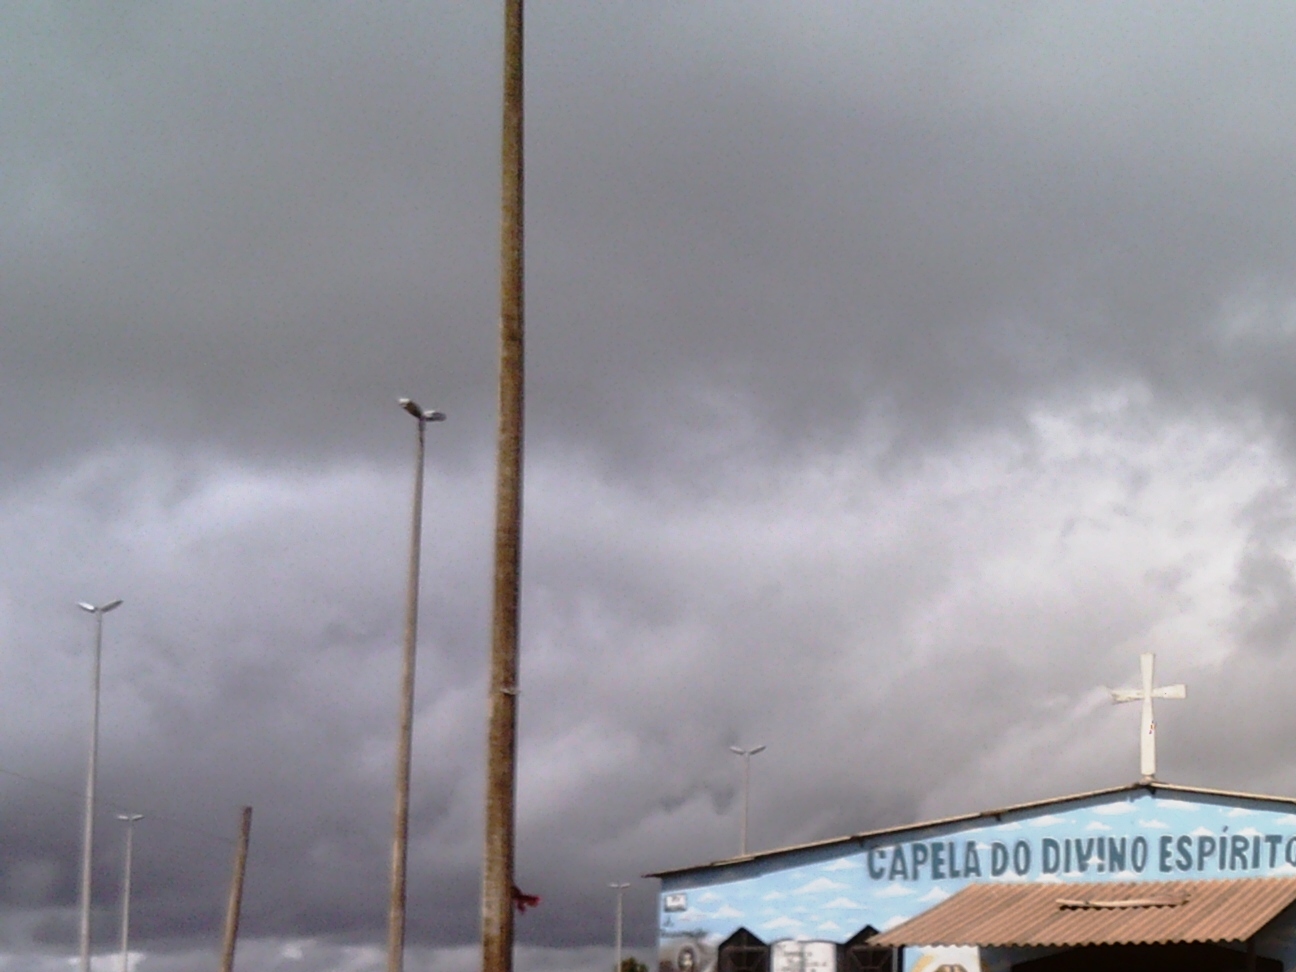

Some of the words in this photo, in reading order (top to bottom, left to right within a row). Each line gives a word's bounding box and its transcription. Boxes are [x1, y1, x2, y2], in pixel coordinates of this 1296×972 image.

[867, 840, 981, 881] CAPELA
[990, 839, 1031, 877] DO
[1042, 835, 1148, 875] DIVINO
